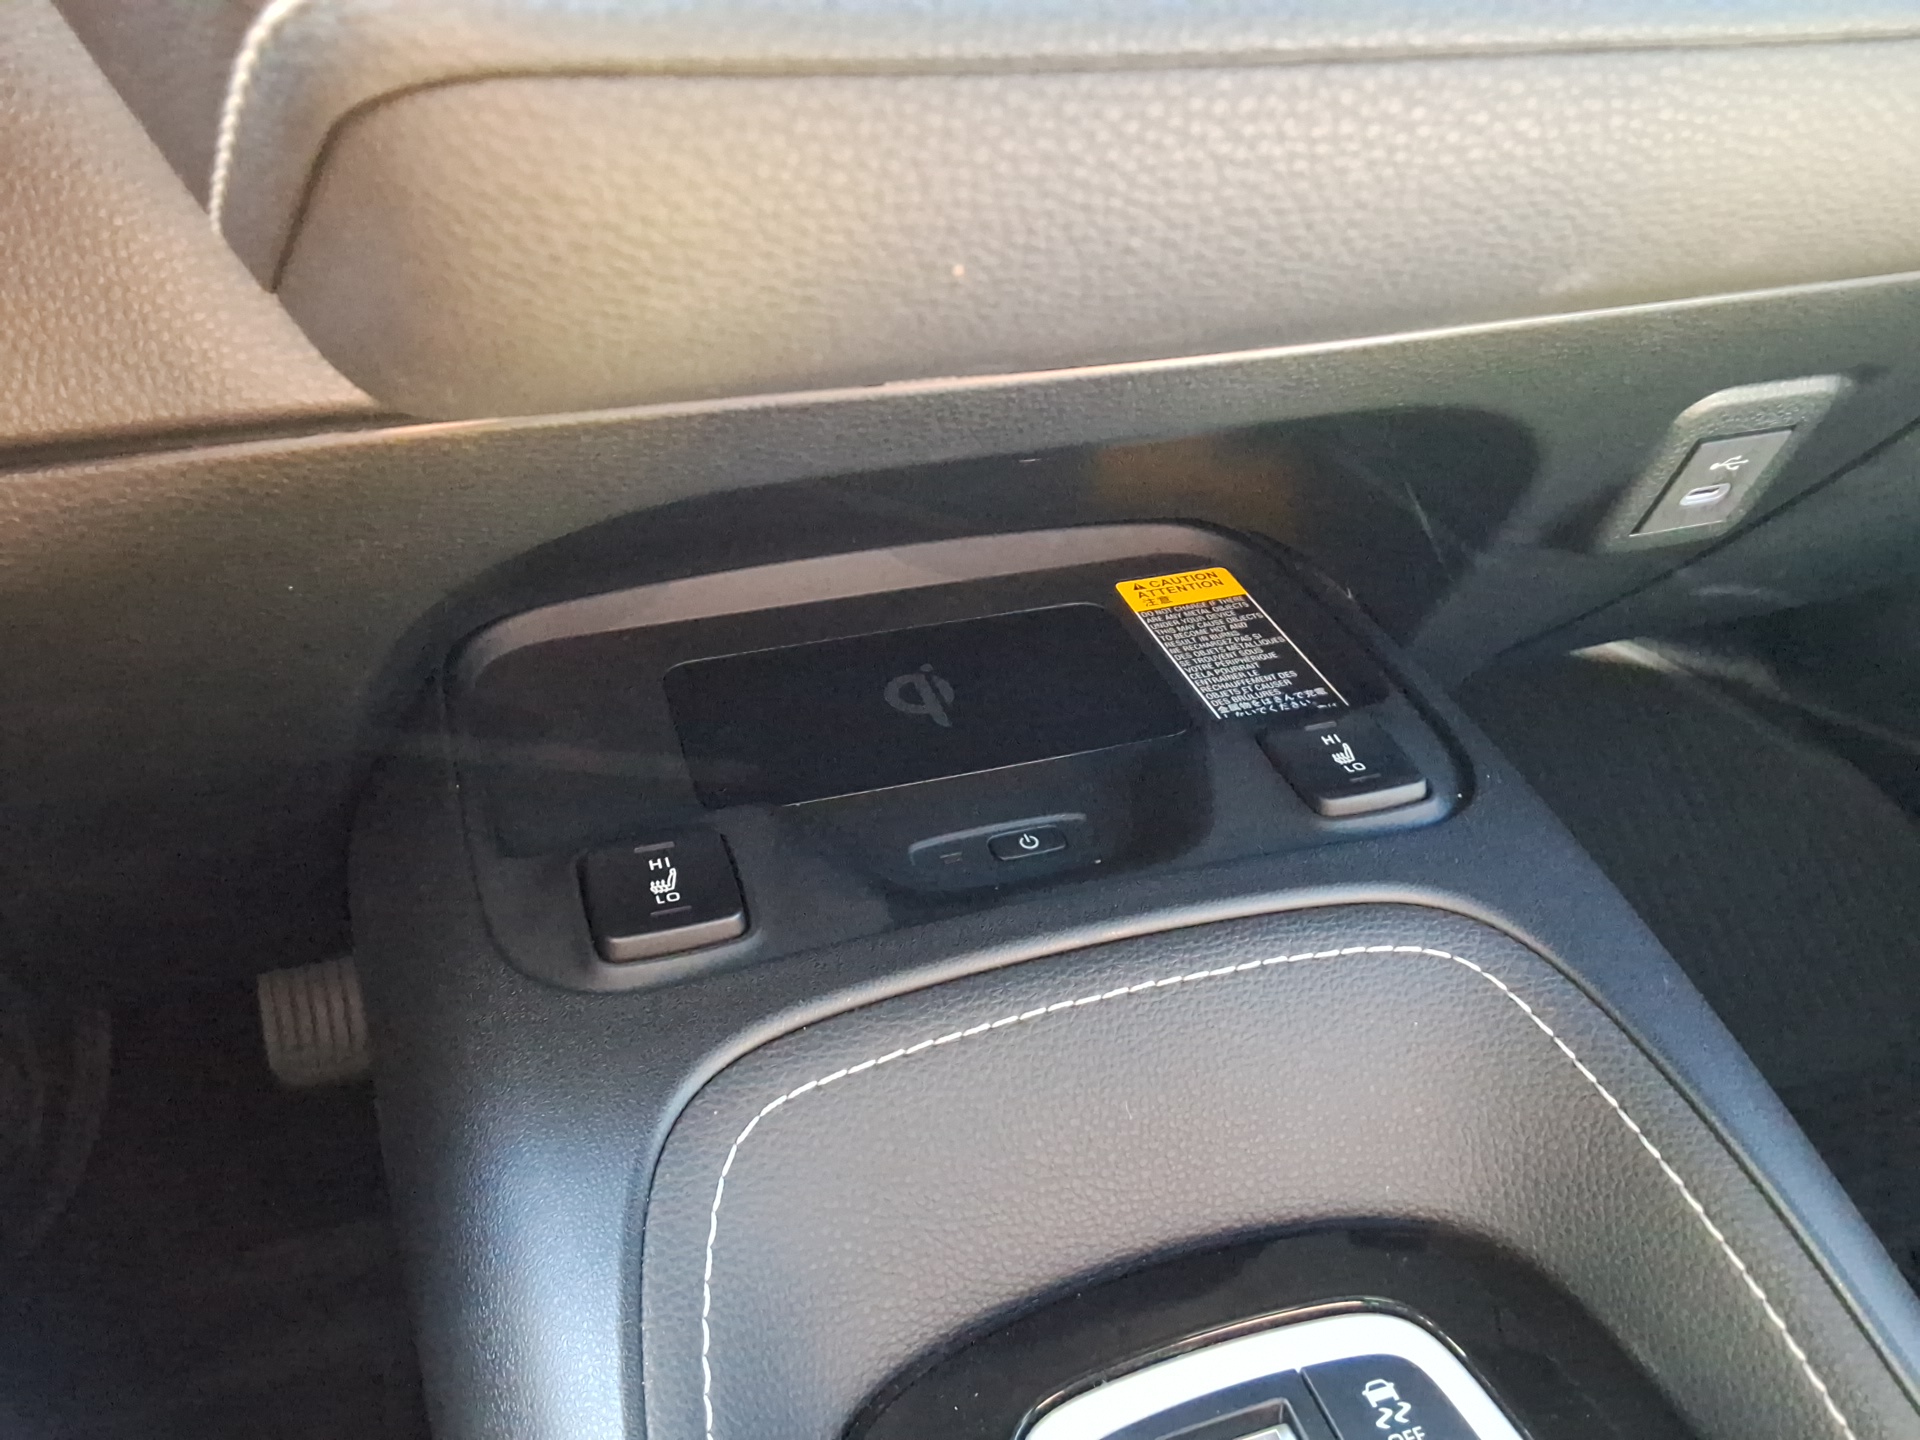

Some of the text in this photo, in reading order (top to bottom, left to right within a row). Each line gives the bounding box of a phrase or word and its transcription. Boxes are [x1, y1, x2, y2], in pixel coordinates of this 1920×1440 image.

[1149, 571, 1218, 588] CAUTION
[1138, 579, 1224, 599] ATTENTION
[1147, 615, 1163, 624] ARE
[1183, 608, 1212, 617] METAL
[1212, 601, 1249, 612] OBJECTS
[1154, 607, 1172, 616] NOT
[1173, 601, 1209, 612] CHARGE
[1218, 595, 1245, 604] THERE
[1150, 621, 1180, 630] UNDER
[1180, 616, 1206, 624] YOUR
[1155, 612, 1264, 635] THIS MAY CAUSE OBJECTS
[1173, 628, 1209, 640] BECOME
[1210, 625, 1228, 633] HOT
[1229, 622, 1248, 630] AND
[1164, 637, 1197, 648] RESULT
[1182, 638, 1234, 651] RECHARGEZ
[1234, 635, 1252, 643] PAS
[1174, 652, 1192, 660] DES
[1193, 646, 1226, 657] OBJETS
[1192, 651, 1237, 664] TROUVENT
[1239, 646, 1264, 656] SOUS
[1184, 662, 1215, 673] VOTRE
[1190, 662, 1260, 680] CELA POURRAIT
[1277, 670, 1298, 679] DES
[1205, 679, 1293, 700] OBJETS ET CAUSER
[1210, 698, 1231, 707] DES
[1321, 733, 1342, 745] HI
[1343, 762, 1366, 773] LO
[648, 857, 670, 871] HI
[655, 891, 680, 904] LO
